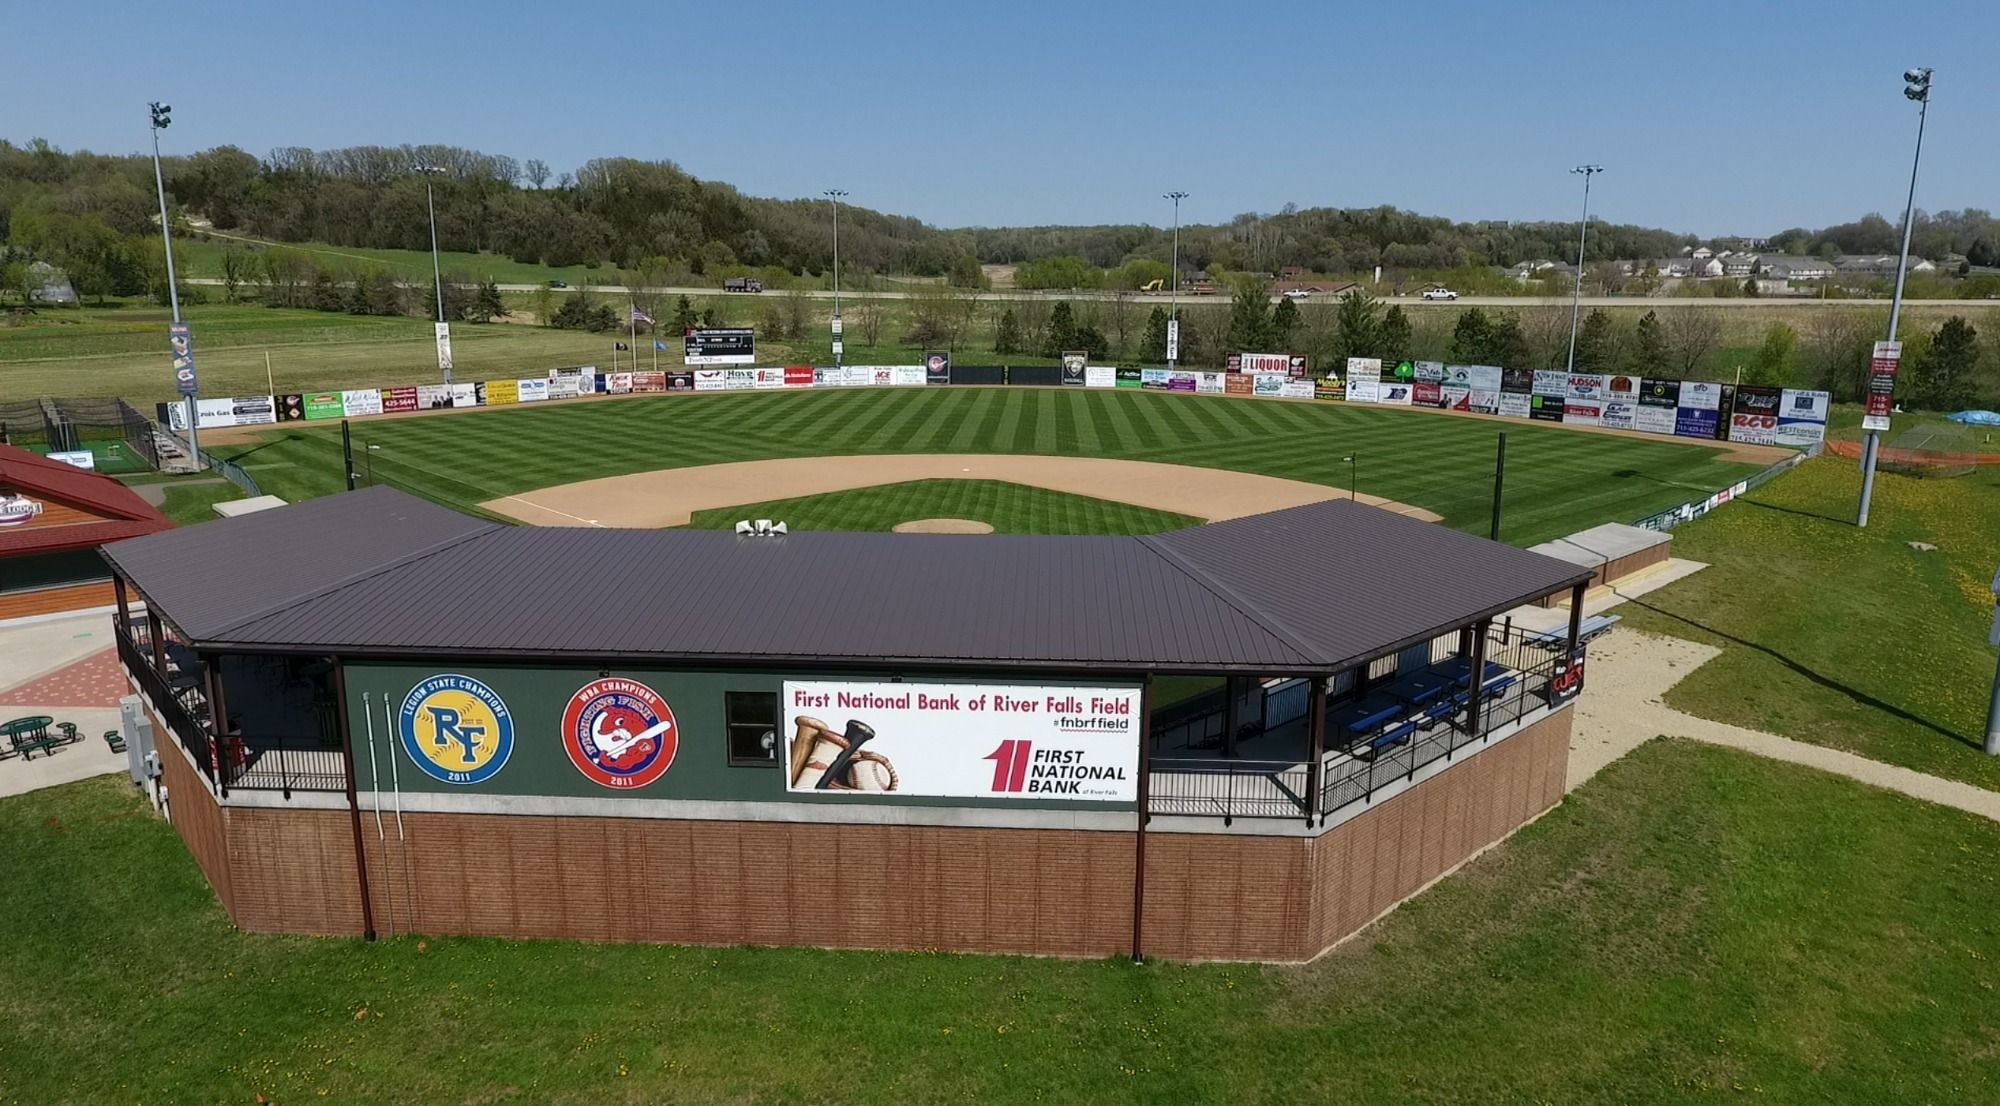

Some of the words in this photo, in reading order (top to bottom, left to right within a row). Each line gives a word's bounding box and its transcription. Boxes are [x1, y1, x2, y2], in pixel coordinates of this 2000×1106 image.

[1250, 358, 1287, 371] LIQUOR
[874, 371, 891, 379] ACE
[1568, 377, 1601, 388] HUDSON
[1693, 384, 1708, 392] sfb
[1733, 415, 1777, 429] RCD
[8, 504, 40, 513] LODGE
[404, 687, 428, 716] LEGION
[427, 678, 456, 691] STATE
[459, 679, 506, 718] CHAMPIONS
[578, 686, 600, 702] WBA
[601, 682, 657, 704] CHAMPIONS
[794, 690, 830, 708] First
[838, 692, 910, 710] National
[918, 693, 960, 711] Bank
[968, 694, 987, 712] of
[994, 695, 1040, 712] River
[1046, 696, 1083, 714] Falls
[1091, 697, 1130, 715] Field
[580, 696, 616, 755] FIGHTING
[618, 696, 654, 721] FISH
[425, 705, 486, 763] RF
[1034, 750, 1085, 764] FIRST
[448, 772, 471, 782] 2011
[1031, 765, 1127, 780] NATIONAL
[611, 776, 633, 786] 2011
[1028, 780, 1082, 794] BANK
